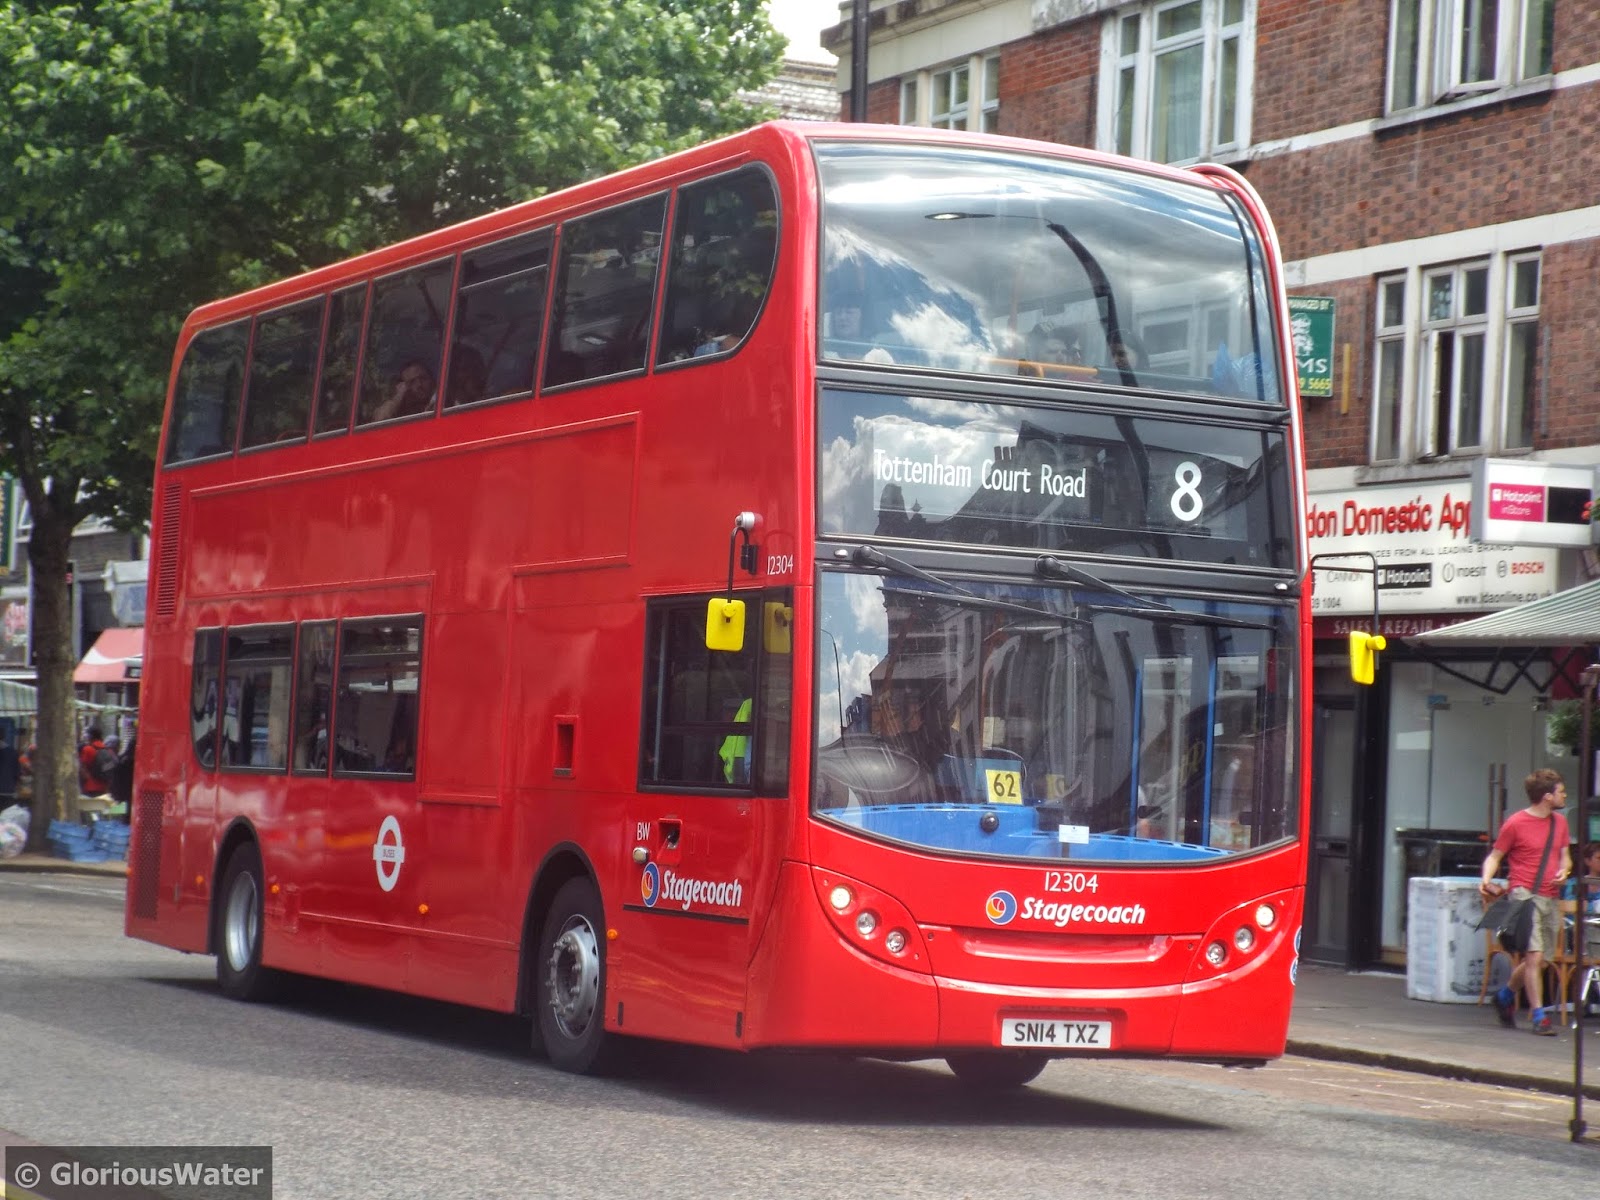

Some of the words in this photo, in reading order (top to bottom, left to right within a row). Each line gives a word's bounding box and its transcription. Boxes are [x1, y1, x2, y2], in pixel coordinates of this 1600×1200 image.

[874, 449, 972, 488] Tottenham
[981, 459, 1032, 493] Court
[1040, 464, 1087, 498] Road
[1170, 461, 1203, 521] 8
[1503, 490, 1542, 504] Hotpoint
[1307, 503, 1338, 538] don
[1343, 495, 1433, 537] Domestic
[1394, 548, 1417, 557] FROM
[1421, 547, 1434, 556] ALL
[1438, 545, 1473, 555] LEADING
[767, 554, 794, 576] 12304
[1511, 562, 1545, 575] BOSCH
[1387, 568, 1431, 587] Hotpoint
[1384, 619, 1433, 634] REPAIR
[993, 773, 1017, 797] 62
[637, 822, 651, 841] BW
[661, 870, 742, 911] Stagecoach
[1044, 872, 1099, 894] 12304
[1020, 897, 1146, 927] Stagecoach
[1014, 1022, 1057, 1043] SN14
[1063, 1024, 1100, 1044] TXZ
